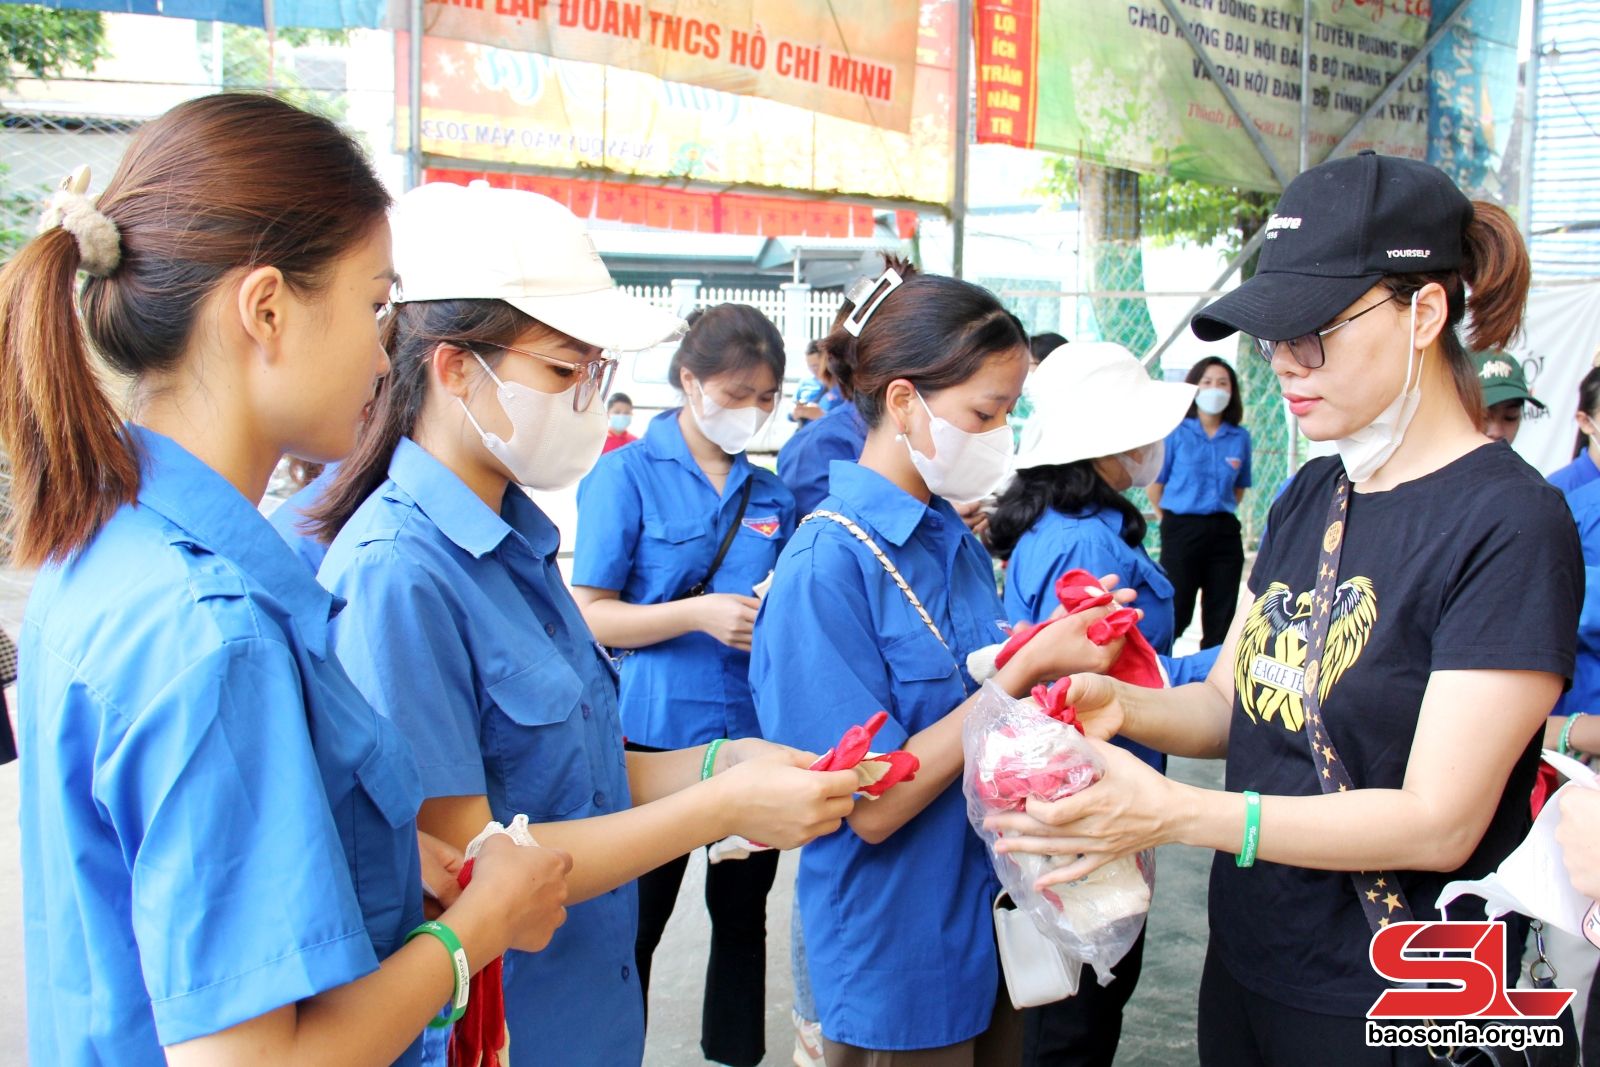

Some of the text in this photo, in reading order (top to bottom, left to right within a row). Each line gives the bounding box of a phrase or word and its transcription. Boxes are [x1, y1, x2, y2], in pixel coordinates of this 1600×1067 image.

[649, 10, 722, 60] TNCS
[730, 24, 768, 71] HỒ
[776, 41, 821, 84] CHÍ
[828, 54, 894, 101] MINH
[1386, 249, 1431, 259] YOURSELF
[1254, 660, 1289, 686] EAGLE
[1290, 671, 1304, 691] TE
